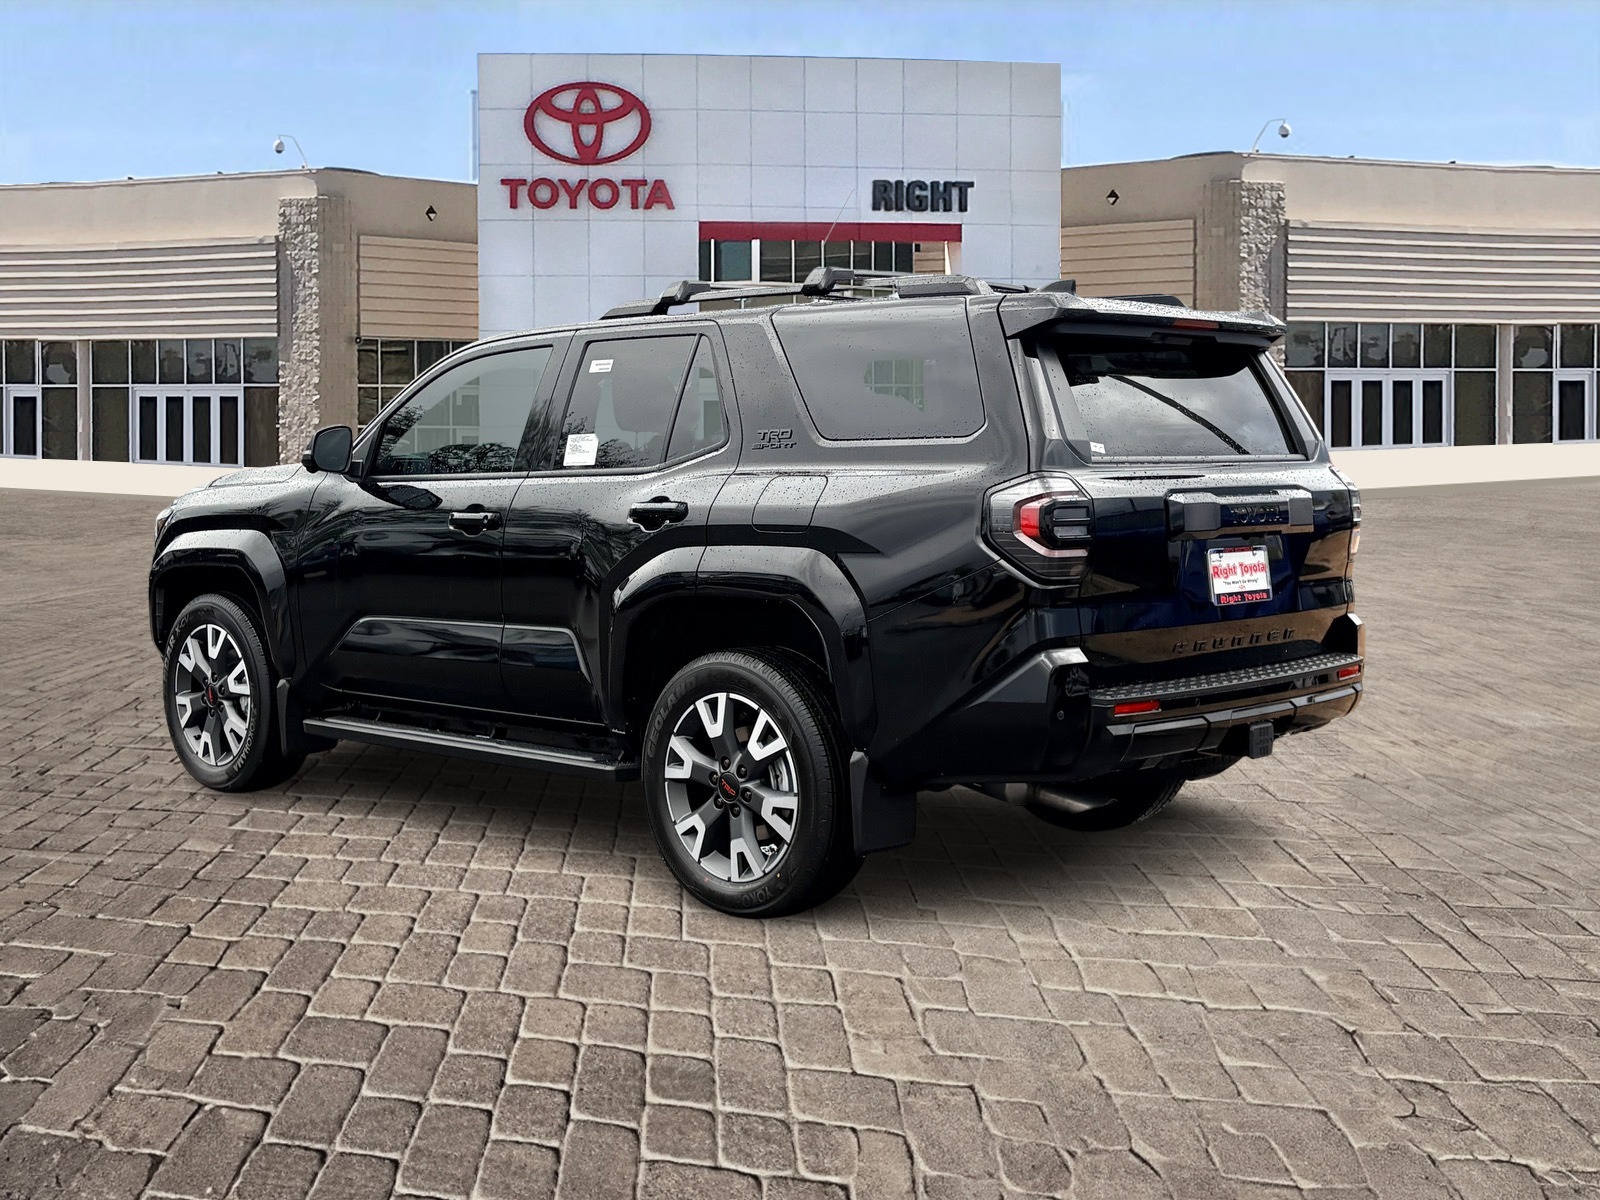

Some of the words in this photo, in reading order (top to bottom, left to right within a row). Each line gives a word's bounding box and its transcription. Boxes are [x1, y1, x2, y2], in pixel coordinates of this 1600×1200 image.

[500, 177, 675, 210] TOYOTA
[871, 179, 975, 213] RIGHT
[757, 429, 793, 443] TRD
[752, 442, 797, 451] SPORT
[1212, 563, 1237, 579] Right
[1238, 561, 1267, 577] Toyota
[1220, 594, 1241, 604] Right
[1244, 592, 1268, 601] Toyota
[721, 777, 738, 797] TRD
